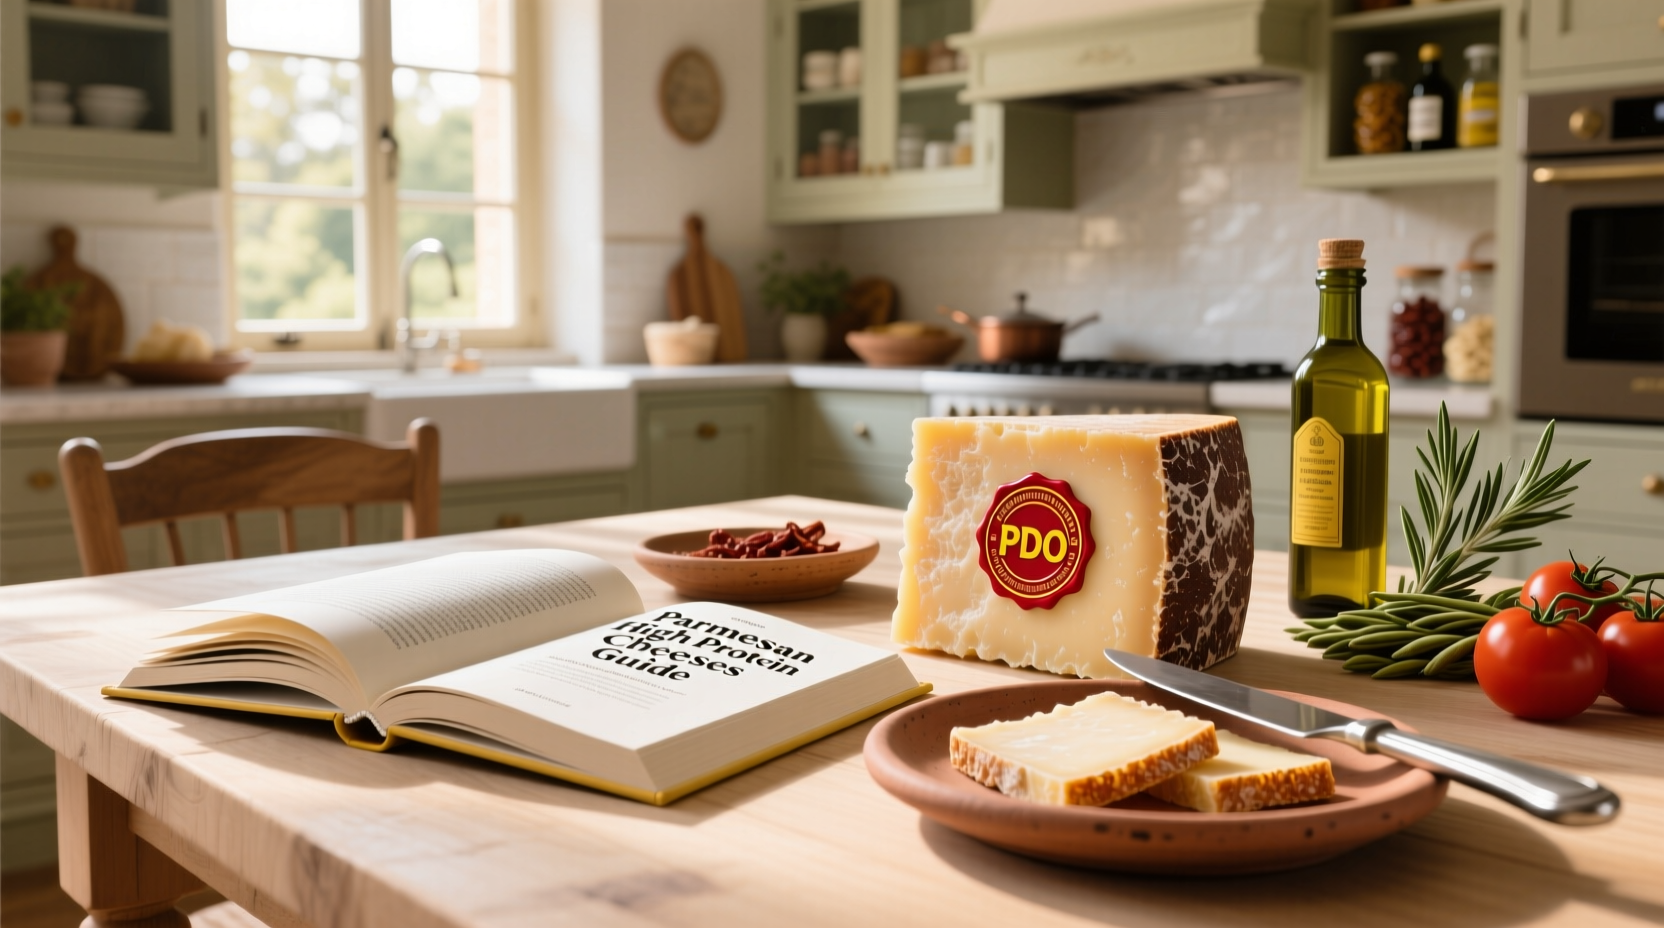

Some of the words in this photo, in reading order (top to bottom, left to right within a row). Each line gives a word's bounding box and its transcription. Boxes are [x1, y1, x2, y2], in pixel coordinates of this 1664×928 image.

[998, 524, 1068, 564] PDO
[603, 634, 745, 677] Cheeses
[612, 621, 692, 644] High
[692, 637, 800, 677] Protein
[653, 611, 815, 664] Parmesan
[591, 647, 691, 681] Guide
